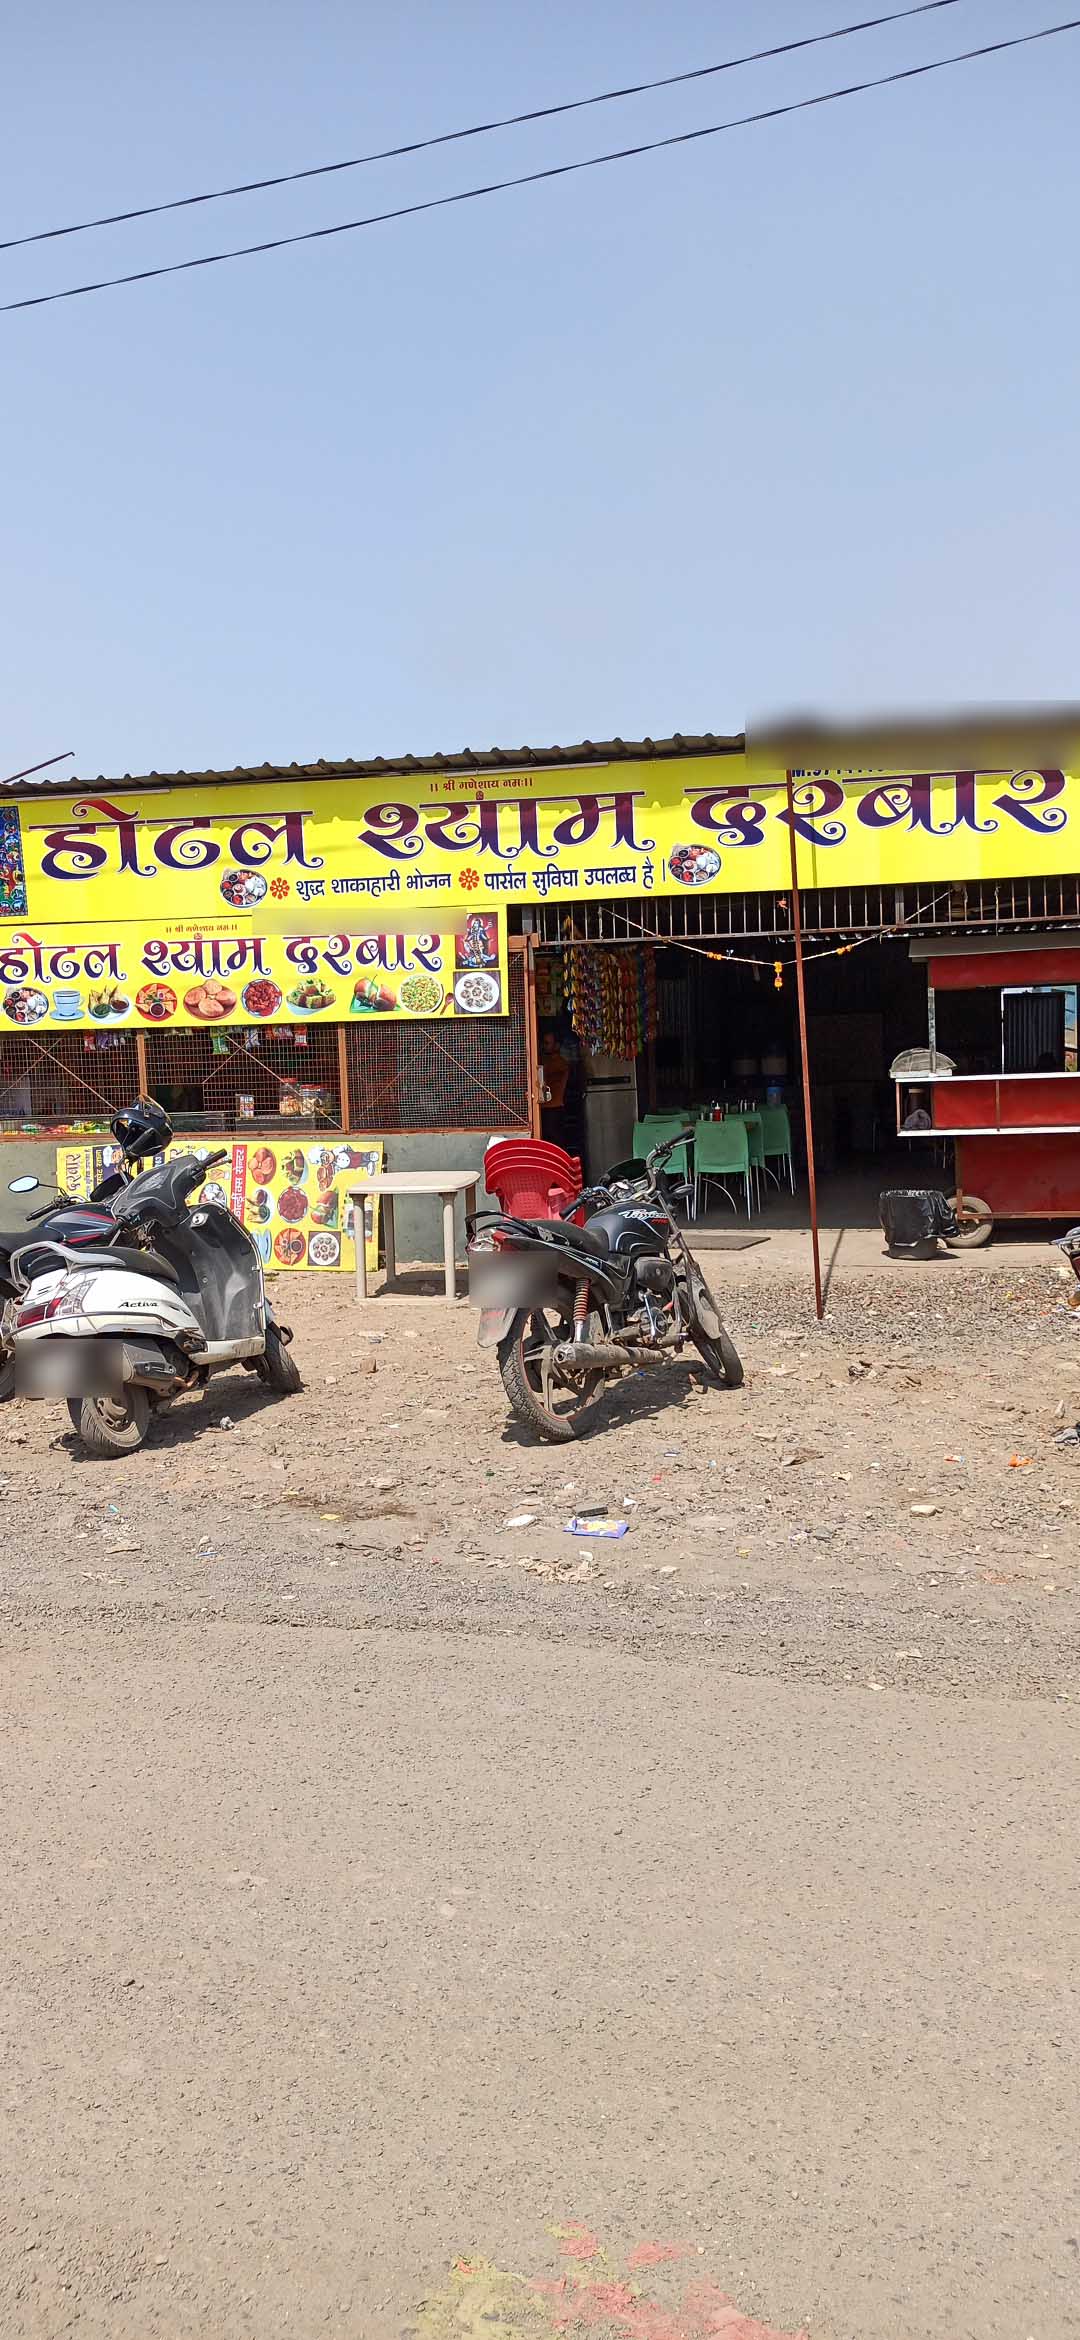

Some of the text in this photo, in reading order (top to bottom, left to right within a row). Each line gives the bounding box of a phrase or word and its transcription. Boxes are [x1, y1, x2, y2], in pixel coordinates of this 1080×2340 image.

[443, 778, 456, 791] श्री
[459, 778, 499, 790] गणेशाय
[28, 769, 1068, 880] होटल श्याम दरबार
[295, 879, 326, 902] शुद्ध
[331, 868, 401, 898] शाकाहारी
[406, 867, 452, 890] भोजन
[484, 863, 527, 890] पार्सल
[0, 932, 443, 984] होटल श्याम दरबार
[117, 1301, 159, 1309] Activa
